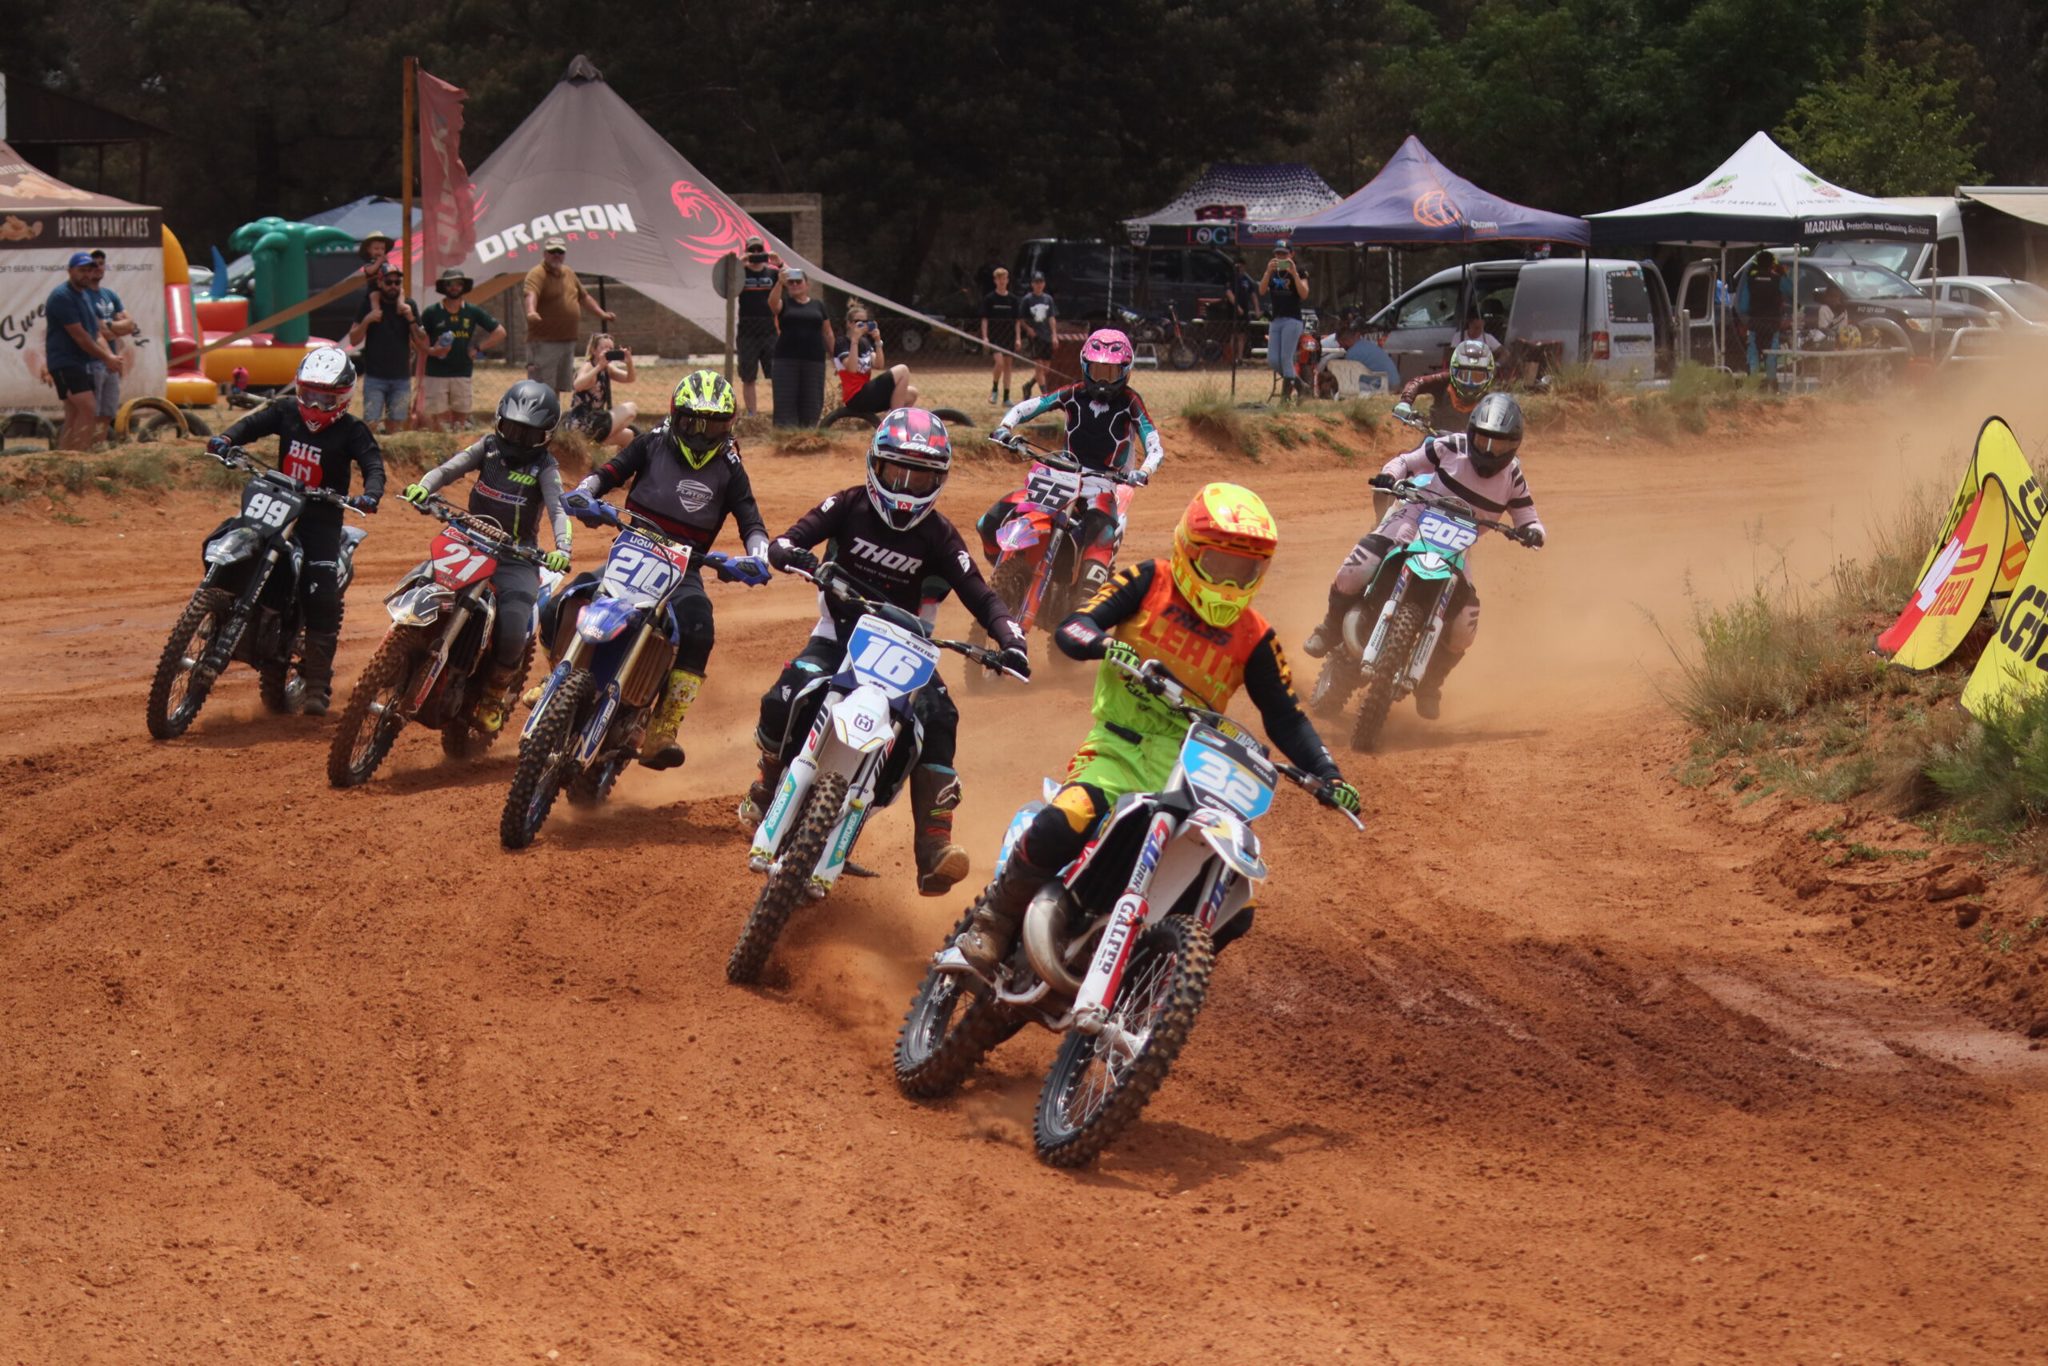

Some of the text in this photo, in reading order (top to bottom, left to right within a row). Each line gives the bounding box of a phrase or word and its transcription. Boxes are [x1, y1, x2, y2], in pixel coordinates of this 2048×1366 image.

[58, 217, 149, 237] PROTEIN PANCAKES
[475, 203, 637, 264] DRAGON
[507, 230, 617, 258] ENRGY
[1804, 220, 1845, 234] MADUNA
[1874, 223, 1884, 231] and
[1885, 222, 1907, 235] Cleaning
[0, 303, 48, 350] Swe
[289, 440, 322, 465] BIG
[290, 462, 312, 481] IN
[1027, 476, 1076, 509] 55
[244, 493, 291, 527] 99
[629, 535, 653, 550] LIQUI
[1419, 516, 1477, 551] 202
[434, 542, 489, 582] 21
[604, 546, 681, 599] 210
[849, 536, 923, 575] THOR
[854, 635, 922, 686] 16
[1190, 750, 1260, 812] 32
